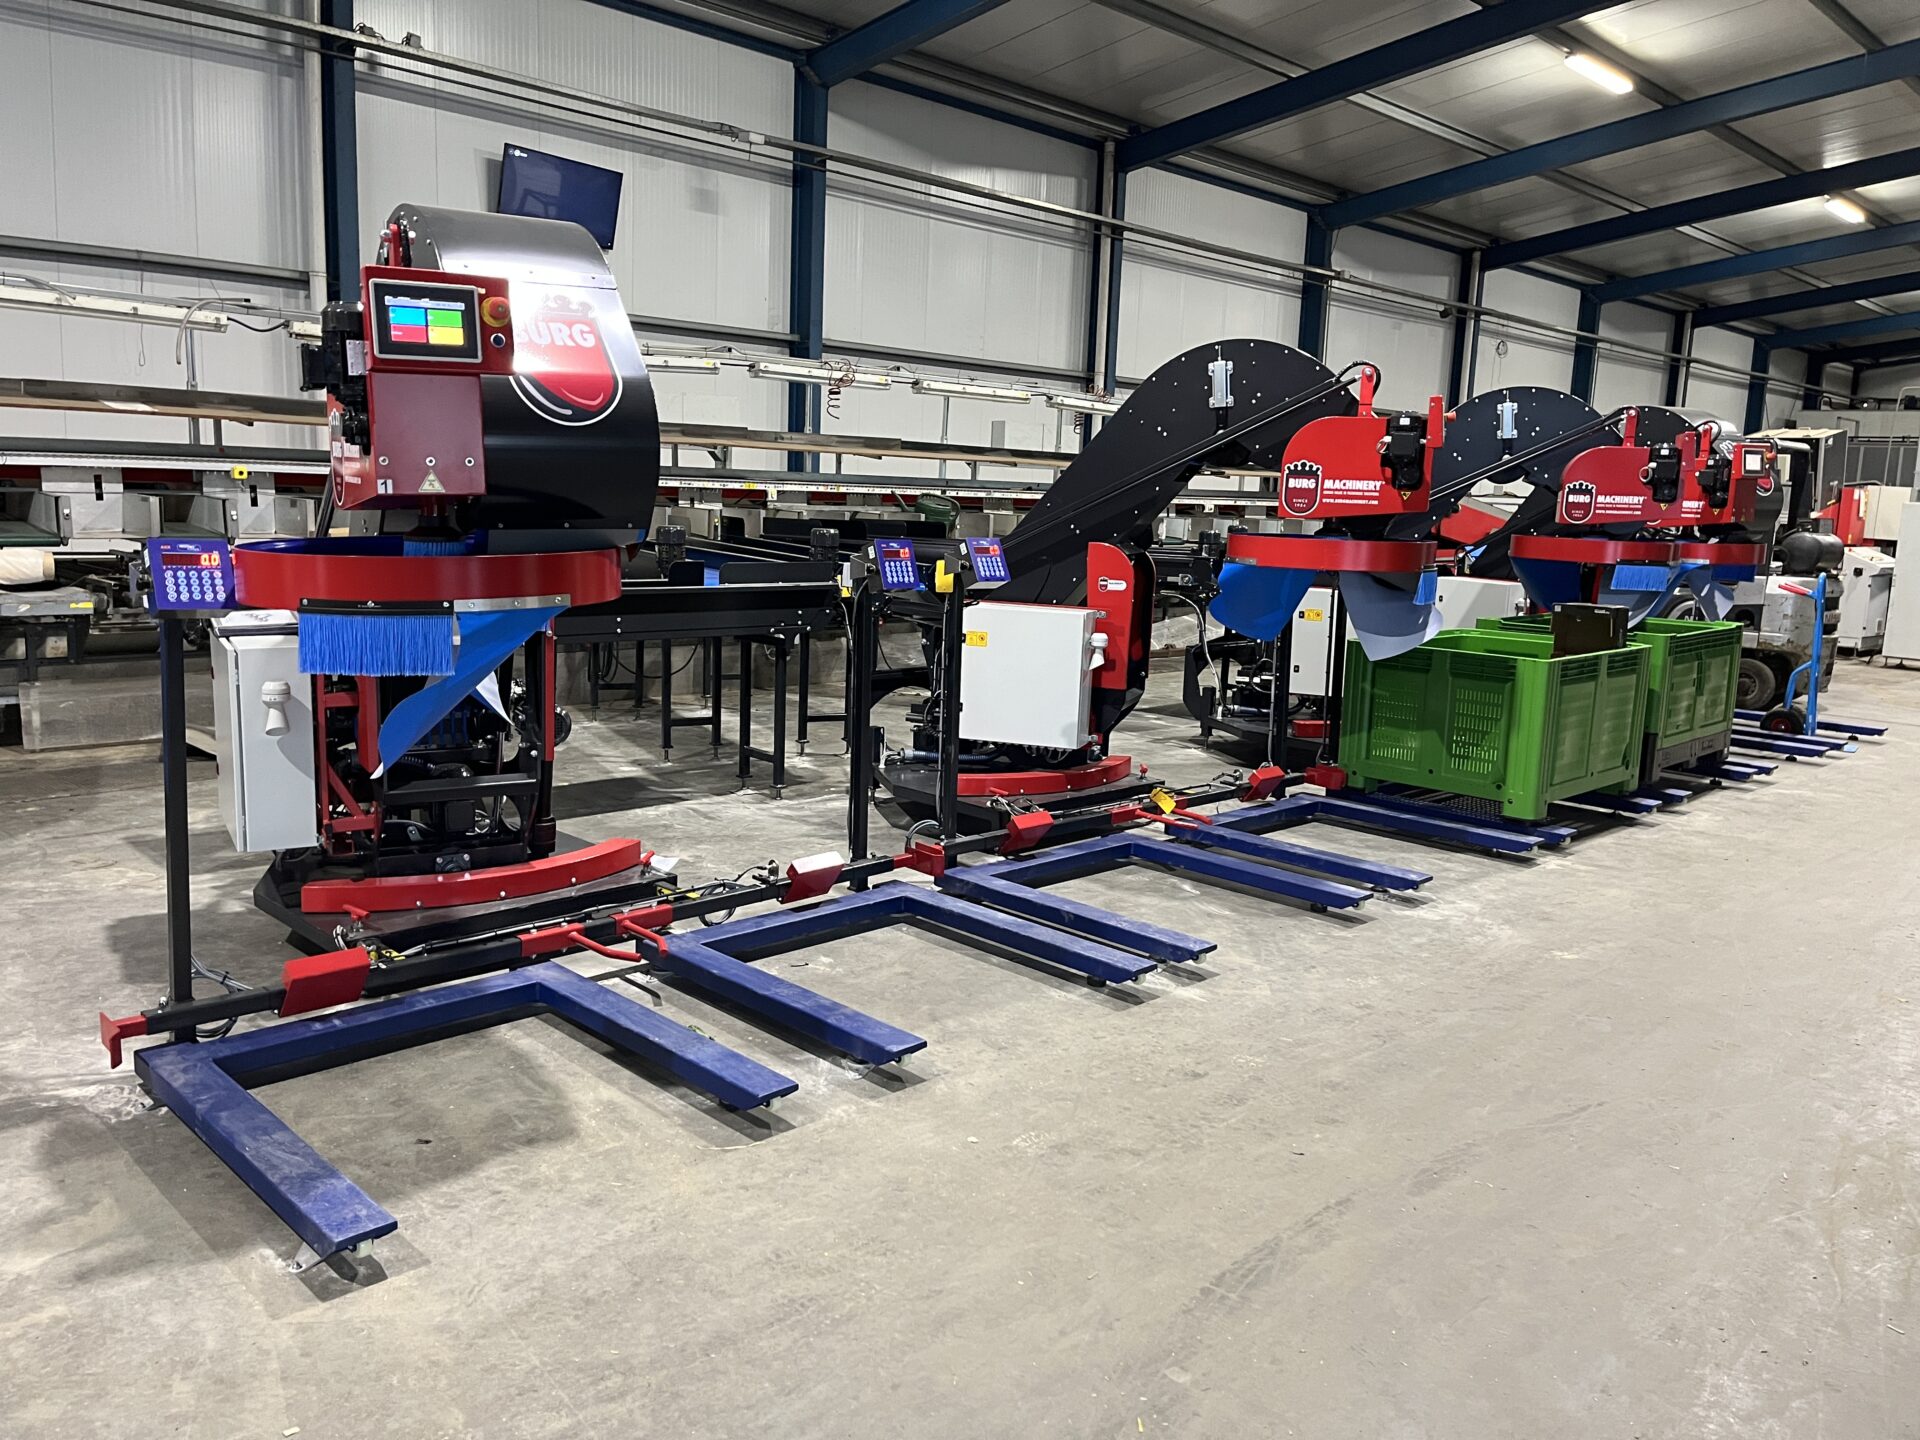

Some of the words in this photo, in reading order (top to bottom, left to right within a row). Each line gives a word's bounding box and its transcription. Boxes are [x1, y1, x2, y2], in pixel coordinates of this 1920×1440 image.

[381, 480, 389, 492] 1
[1288, 478, 1316, 489] BURG
[1323, 479, 1382, 491] MACHINERY
[1568, 494, 1591, 503] BURG
[1596, 495, 1644, 504] MACHINERY
